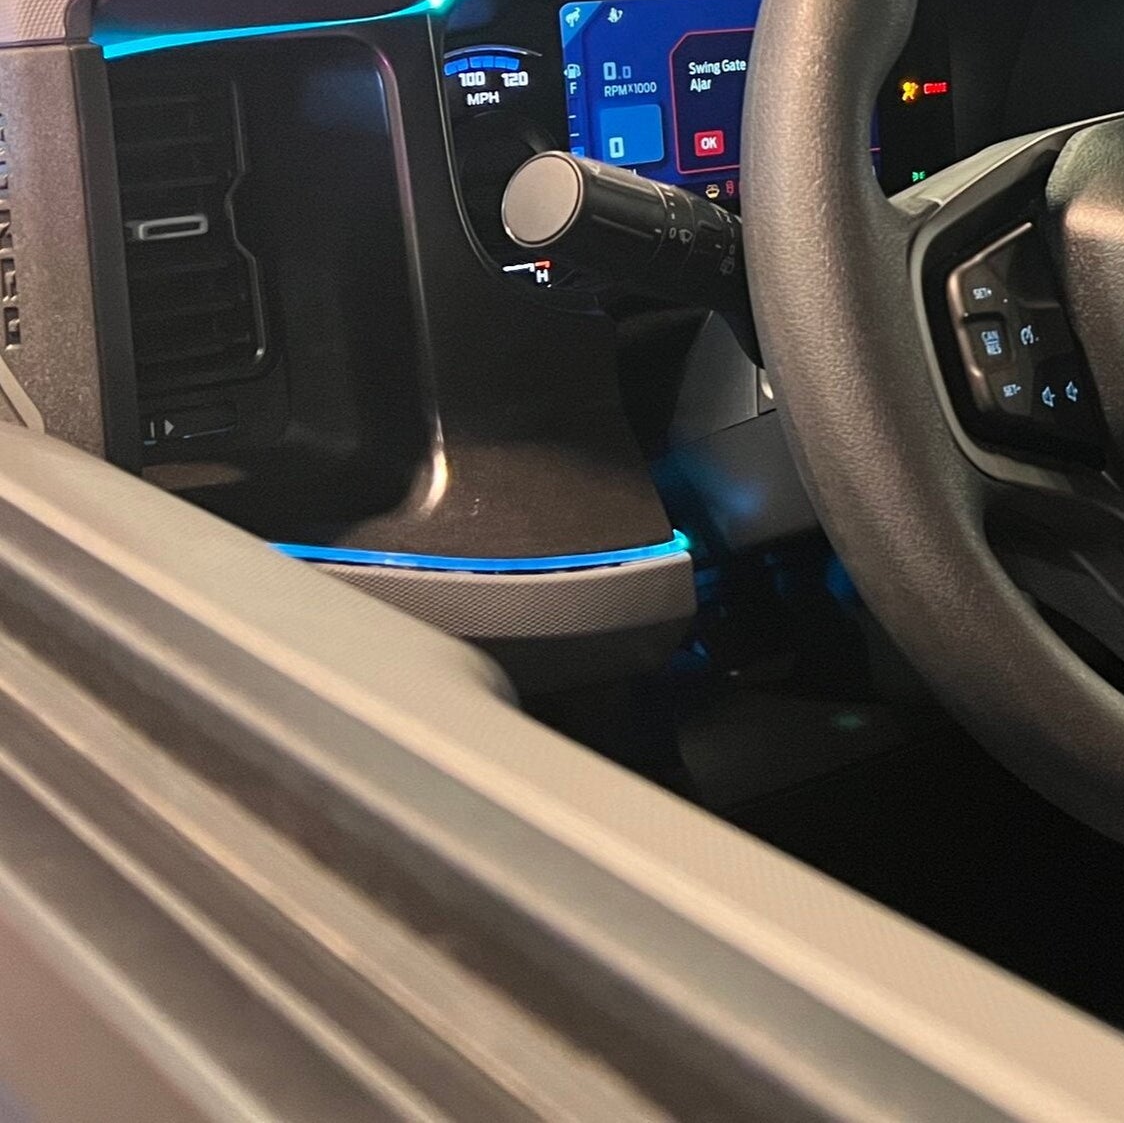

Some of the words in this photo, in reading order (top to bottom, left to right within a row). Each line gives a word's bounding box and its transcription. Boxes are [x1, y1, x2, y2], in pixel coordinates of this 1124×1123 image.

[688, 61, 721, 76] Swing
[721, 59, 747, 72] Gate
[458, 71, 486, 87] 100
[501, 71, 529, 87] 120
[690, 78, 712, 93] Ajar
[569, 82, 577, 94] F
[466, 91, 500, 105] MPH
[609, 137, 624, 158] 0
[701, 137, 717, 150] OK
[536, 269, 549, 283] H
